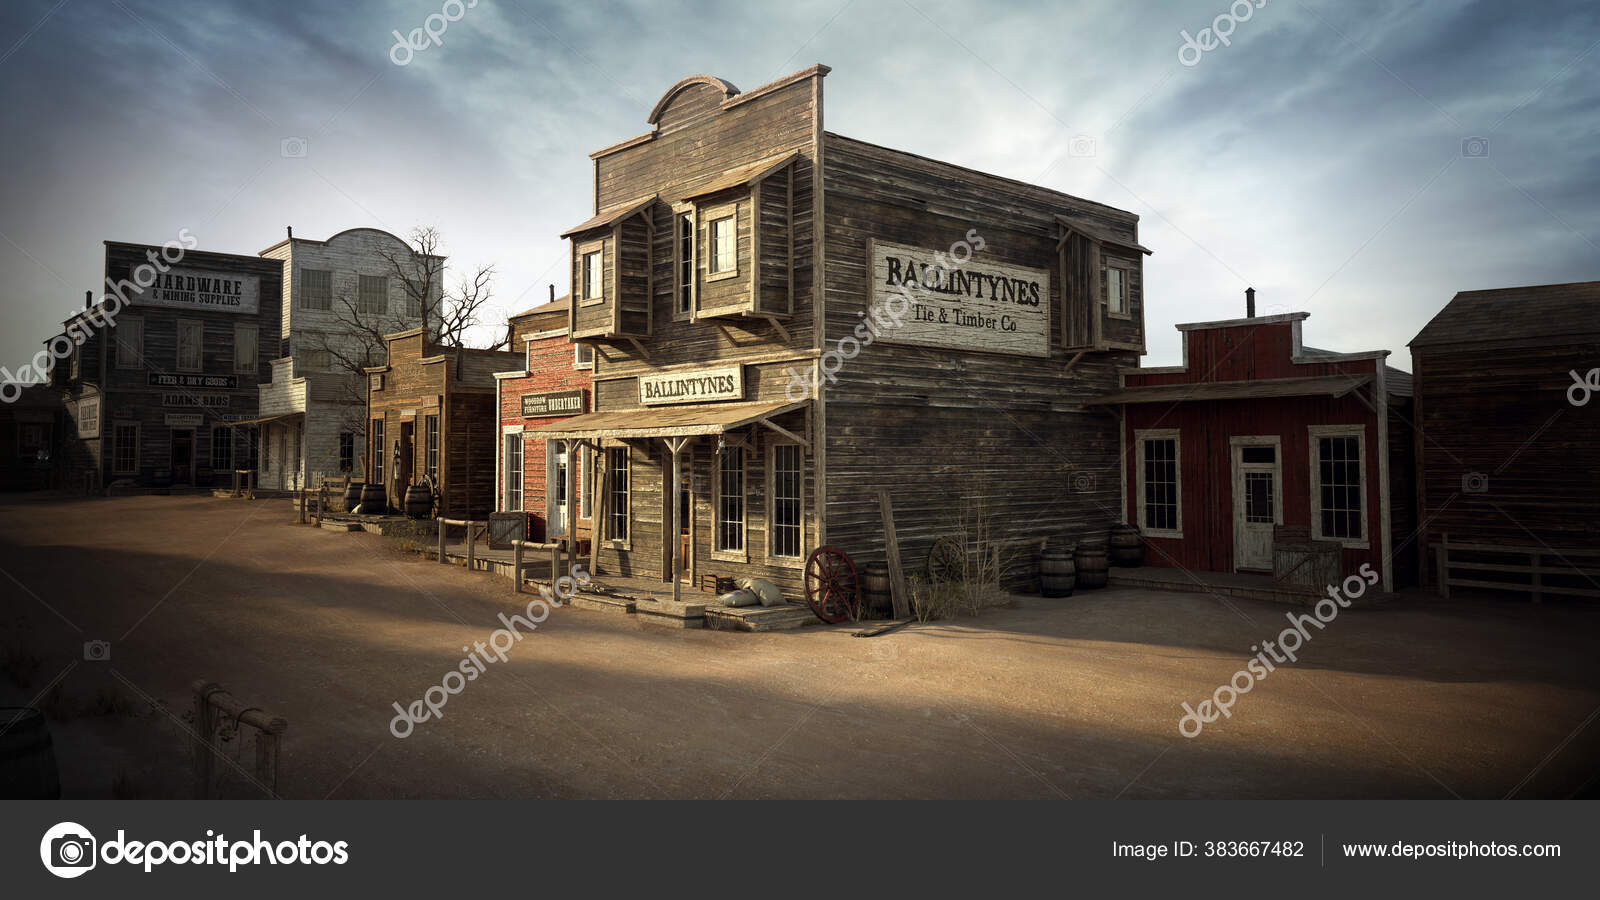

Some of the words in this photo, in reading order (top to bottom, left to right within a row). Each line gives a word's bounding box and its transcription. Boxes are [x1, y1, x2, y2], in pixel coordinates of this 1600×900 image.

[886, 256, 1040, 307] BALLINTYNES
[163, 289, 195, 303] MINING
[199, 293, 241, 306] SUPPLIES
[912, 303, 934, 322] Tie
[939, 308, 948, 324] &
[953, 308, 997, 330] Timber
[1001, 315, 1017, 331] Co
[205, 377, 228, 386] GOODS
[645, 374, 734, 398] BALLINTYNES
[164, 393, 199, 406] ADAMS
